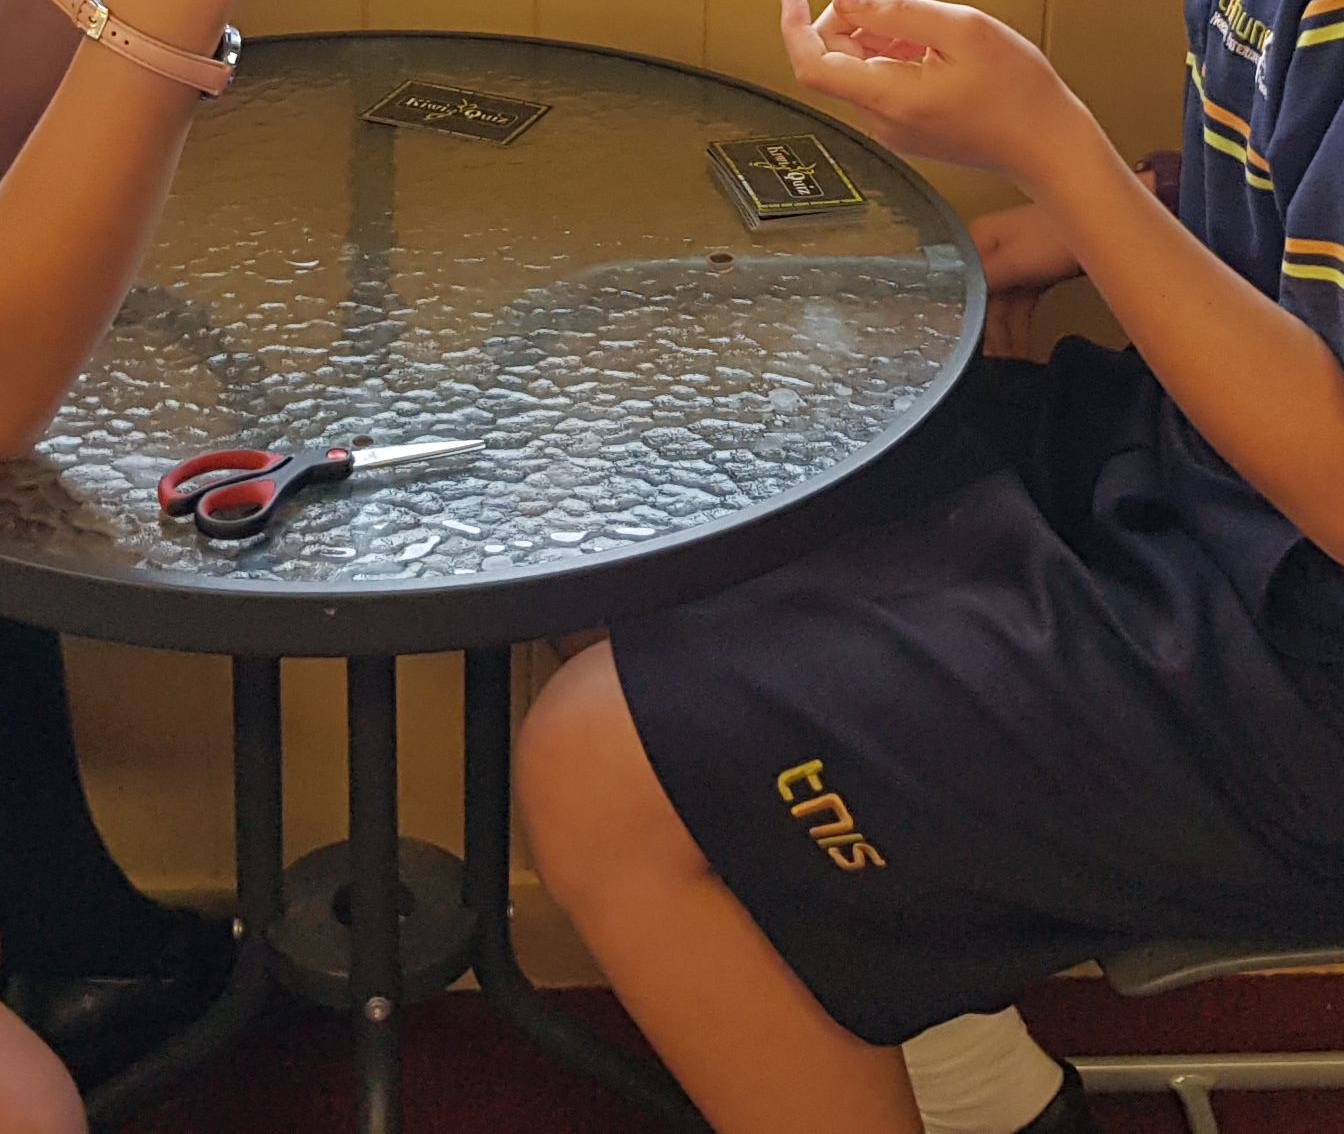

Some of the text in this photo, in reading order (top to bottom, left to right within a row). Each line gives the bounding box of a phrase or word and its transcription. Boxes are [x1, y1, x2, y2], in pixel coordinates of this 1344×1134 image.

[406, 96, 509, 125] Kiwi Quiz
[783, 171, 815, 196] Quiz
